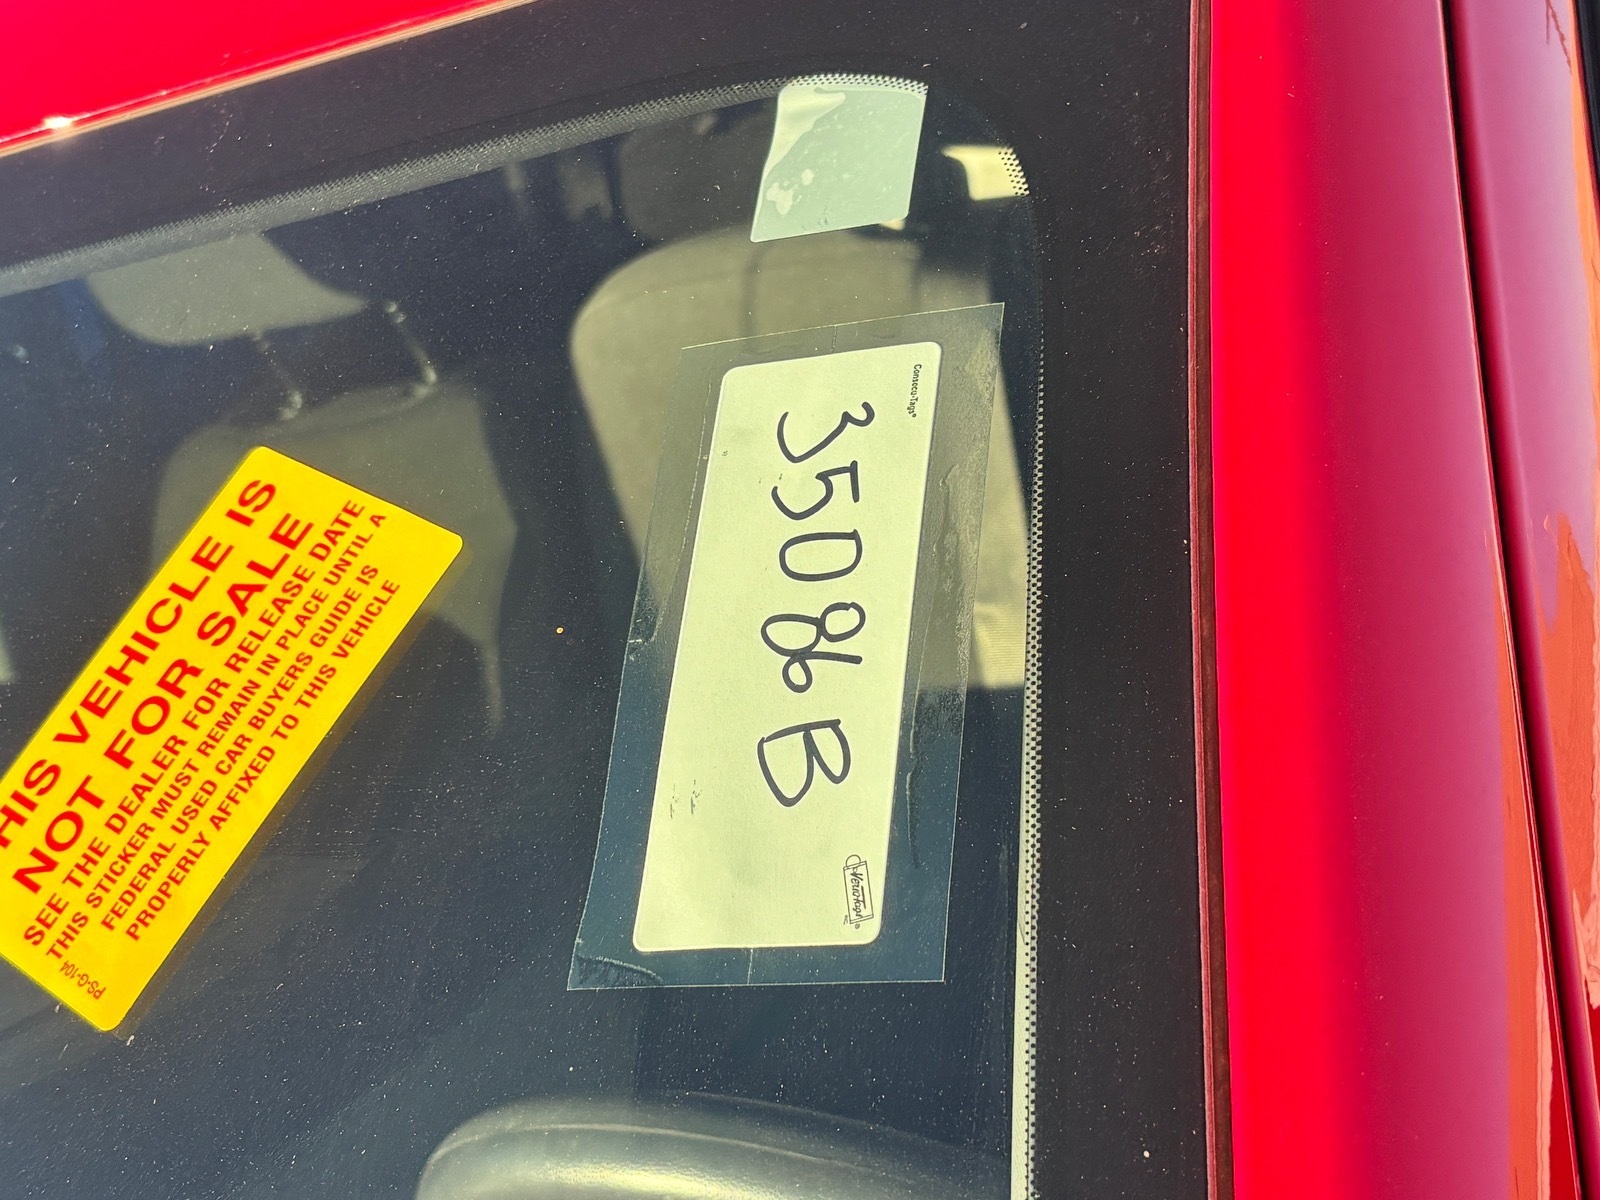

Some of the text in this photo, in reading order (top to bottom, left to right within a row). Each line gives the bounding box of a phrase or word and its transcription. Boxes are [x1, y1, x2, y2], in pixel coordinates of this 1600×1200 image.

[0, 480, 276, 849] HIS VEHICLE IS
[12, 513, 314, 894] NOT FOR SALE
[22, 501, 364, 946] SEE THE DEALER FOR RELEASE DATE
[45, 513, 387, 959] THIS STICKER MUST REMAIN IN PLACE UNTIL A
[100, 565, 380, 931] FEDERAL USED CAR BUYERS GUIDE IS
[124, 580, 401, 941] PROPERLY AFFIXED TO THIS VEHICLE
